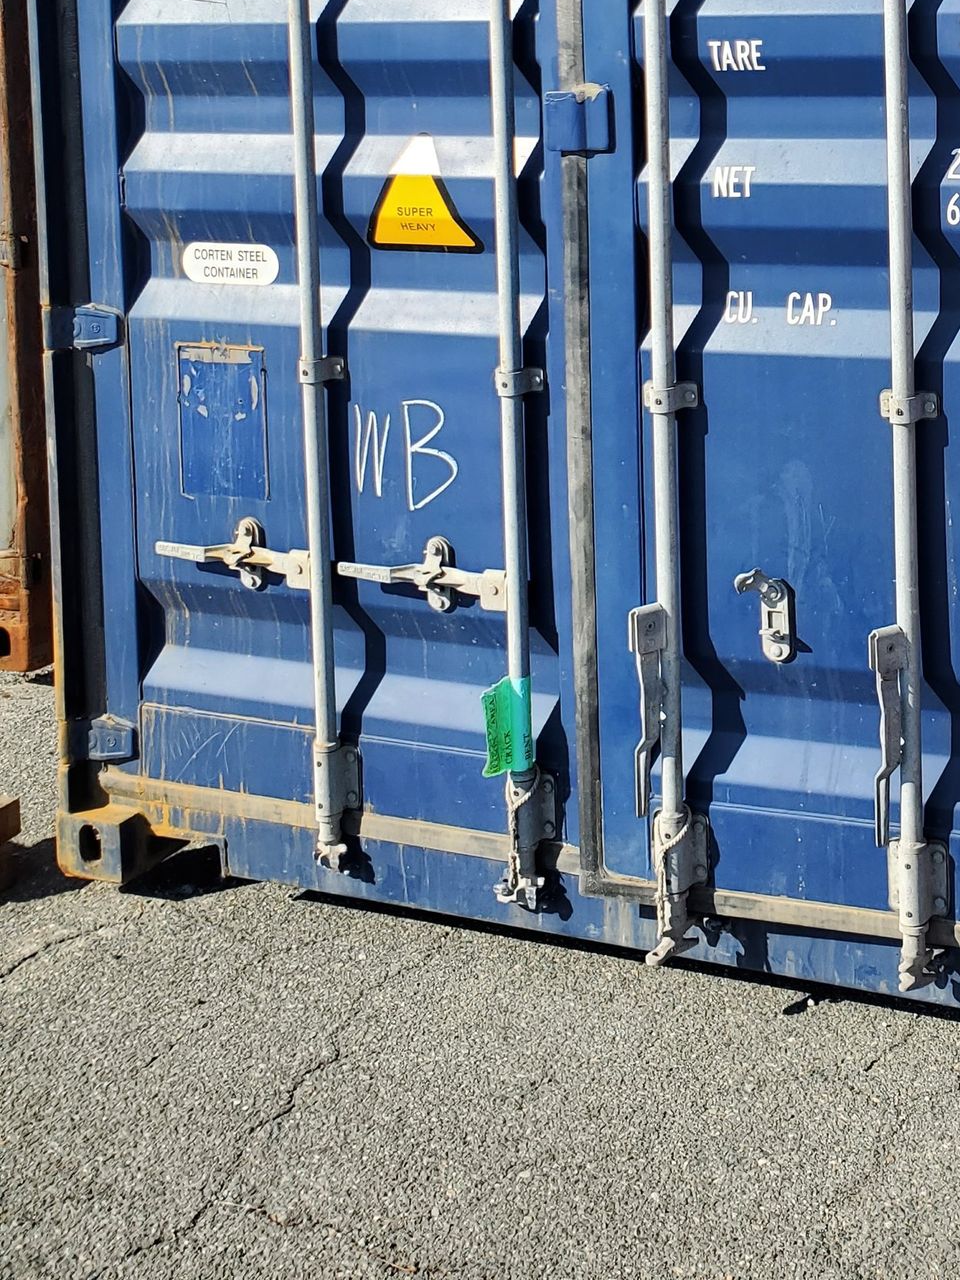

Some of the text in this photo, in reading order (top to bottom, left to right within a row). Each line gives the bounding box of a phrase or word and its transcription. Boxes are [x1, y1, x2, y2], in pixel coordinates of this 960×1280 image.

[707, 39, 766, 71] TARE
[713, 166, 756, 198] NET
[396, 206, 433, 217] SUPER
[400, 222, 435, 232] HEAVY
[194, 248, 267, 263] CORTEN STEEL
[203, 266, 258, 279] CONTAINER
[725, 290, 837, 326] CU. CAP.
[503, 730, 513, 765] CRACK
[522, 733, 533, 761] BENT
